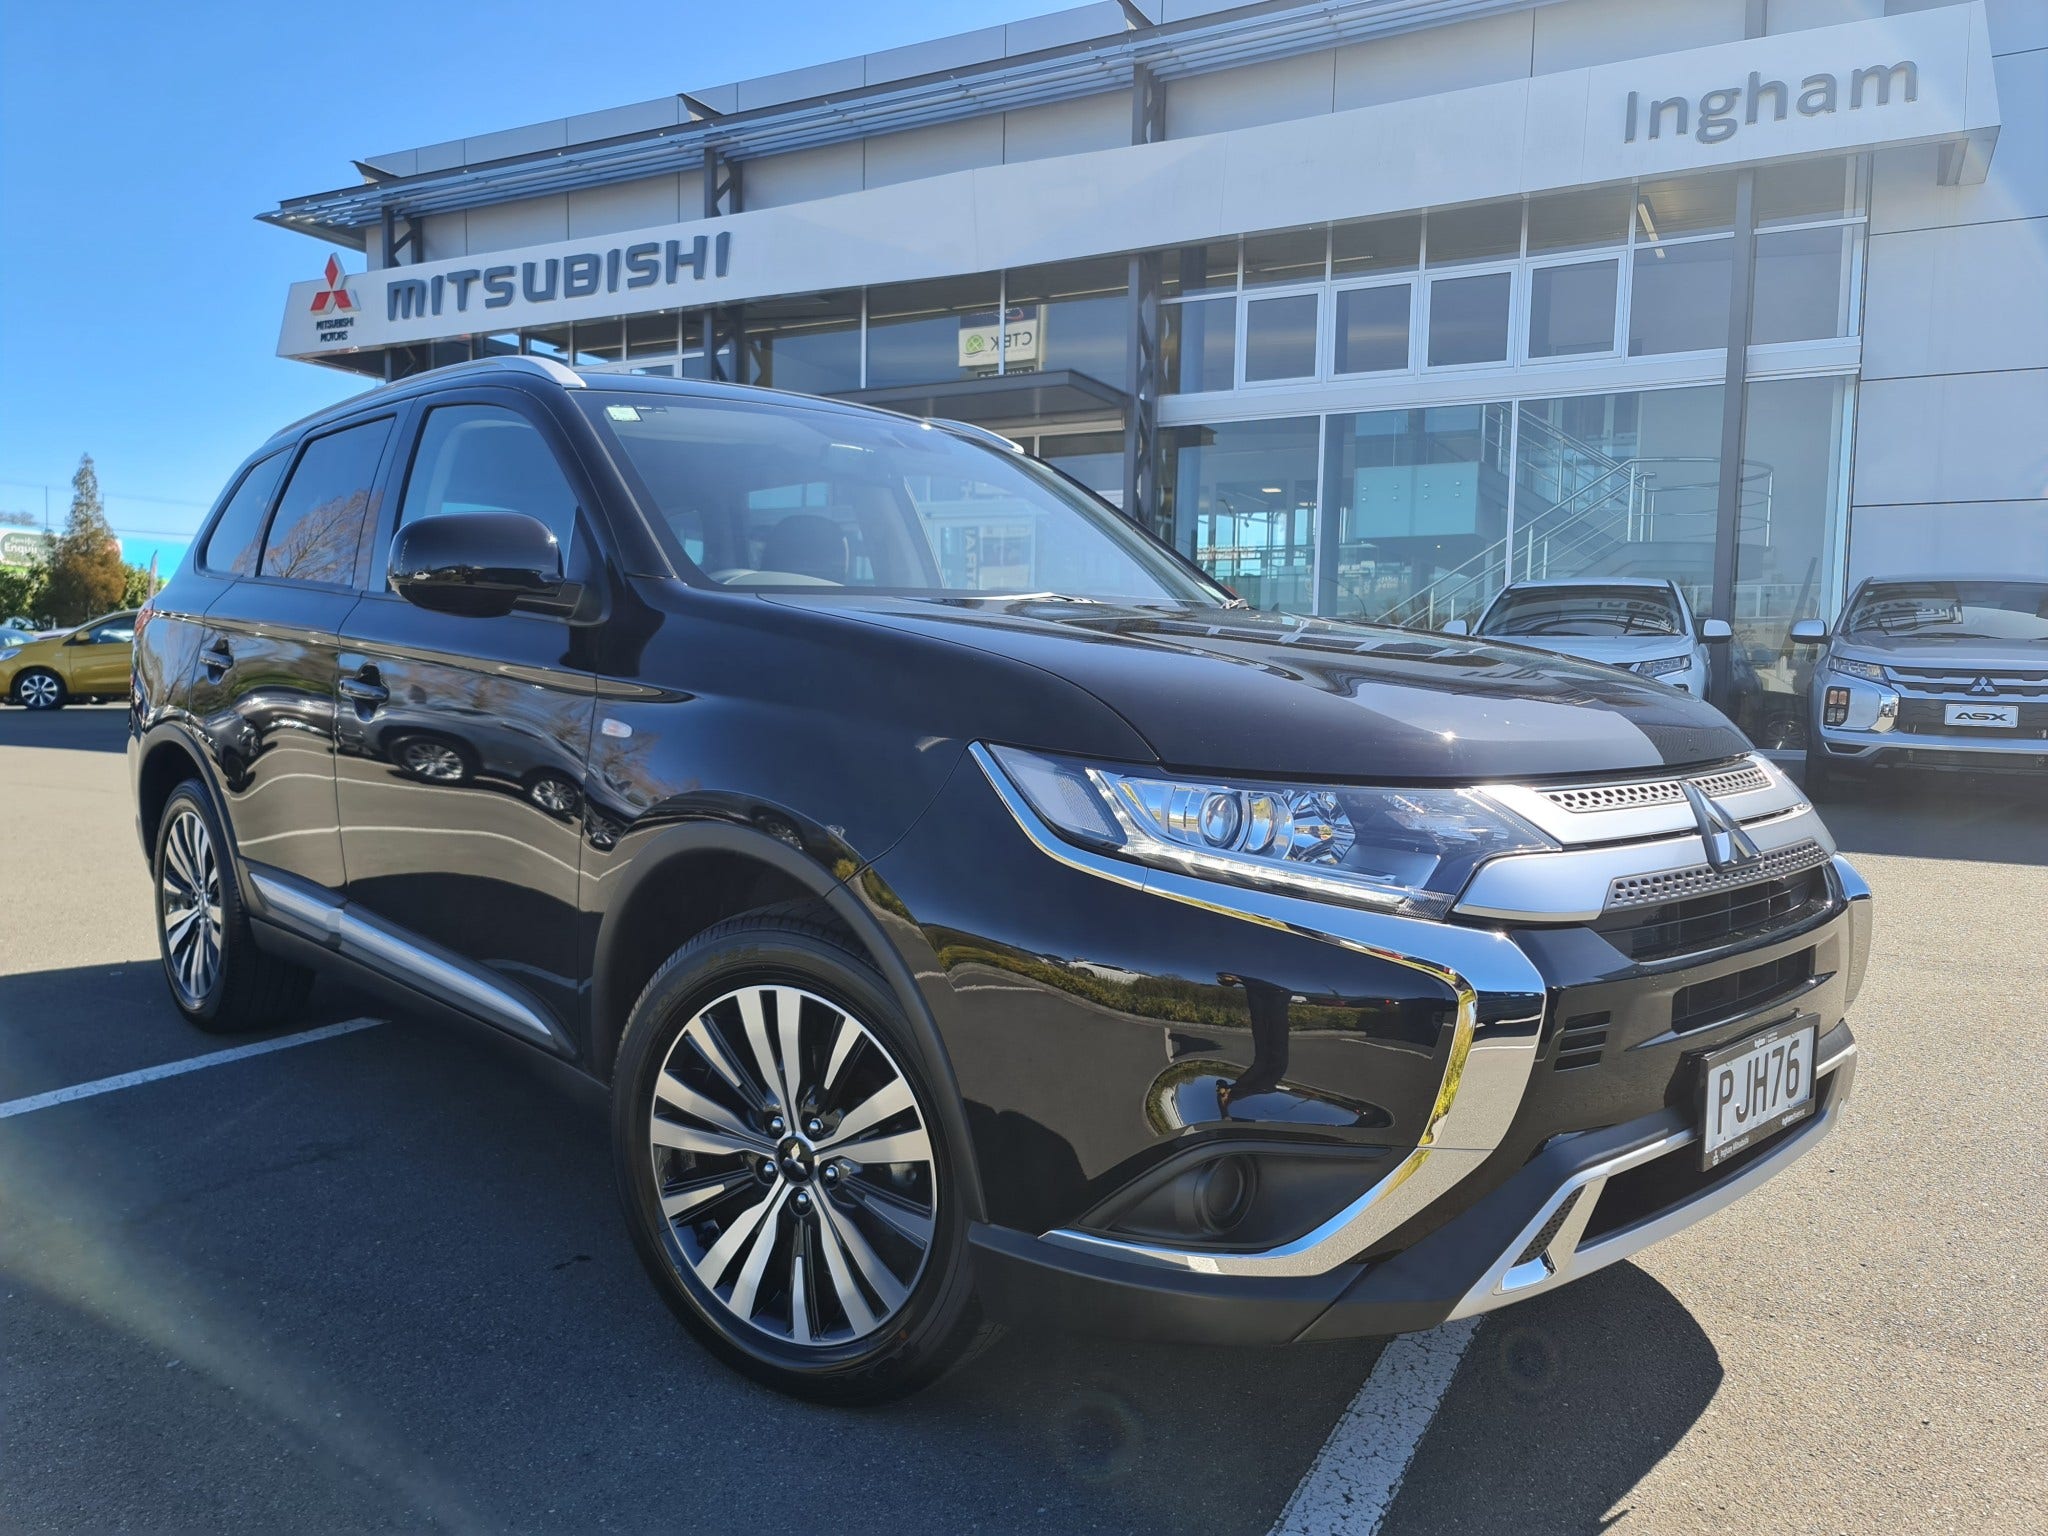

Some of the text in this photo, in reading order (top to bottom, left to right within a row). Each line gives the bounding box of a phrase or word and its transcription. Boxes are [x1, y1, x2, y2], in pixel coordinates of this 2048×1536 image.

[1624, 60, 1918, 144] Ingham
[387, 231, 731, 321] MITSUBISHI
[316, 317, 354, 330] MITSUBISHI
[320, 331, 348, 342] MOTORS
[1955, 712, 2009, 721] ASX
[1717, 1039, 1800, 1135] PJH76
